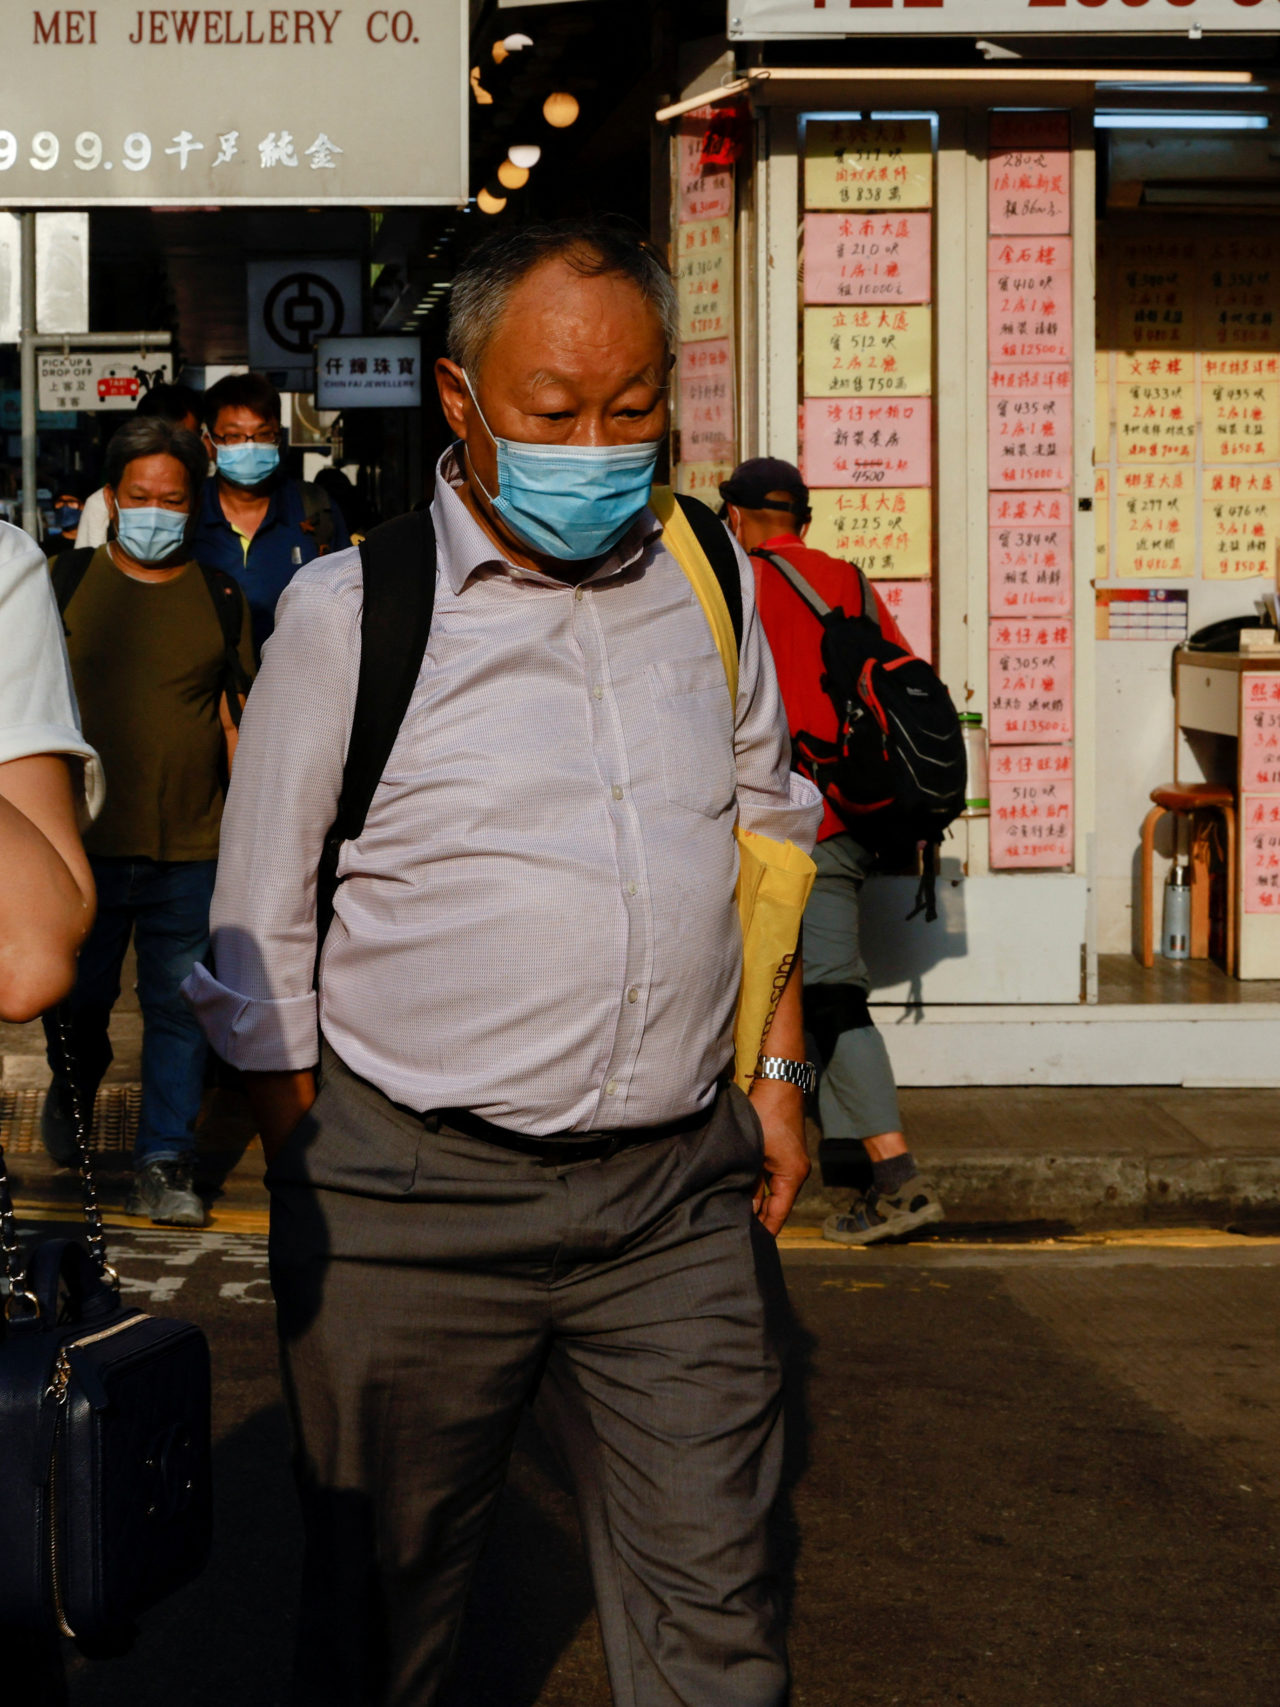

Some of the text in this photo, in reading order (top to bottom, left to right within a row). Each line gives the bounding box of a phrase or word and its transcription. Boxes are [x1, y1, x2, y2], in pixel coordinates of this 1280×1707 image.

[33, 10, 97, 45] MEI
[129, 10, 342, 45] JEWELLERY
[366, 10, 420, 44] CO.
[42, 359, 66, 367] PICK
[42, 368, 93, 377] DROP OFF
